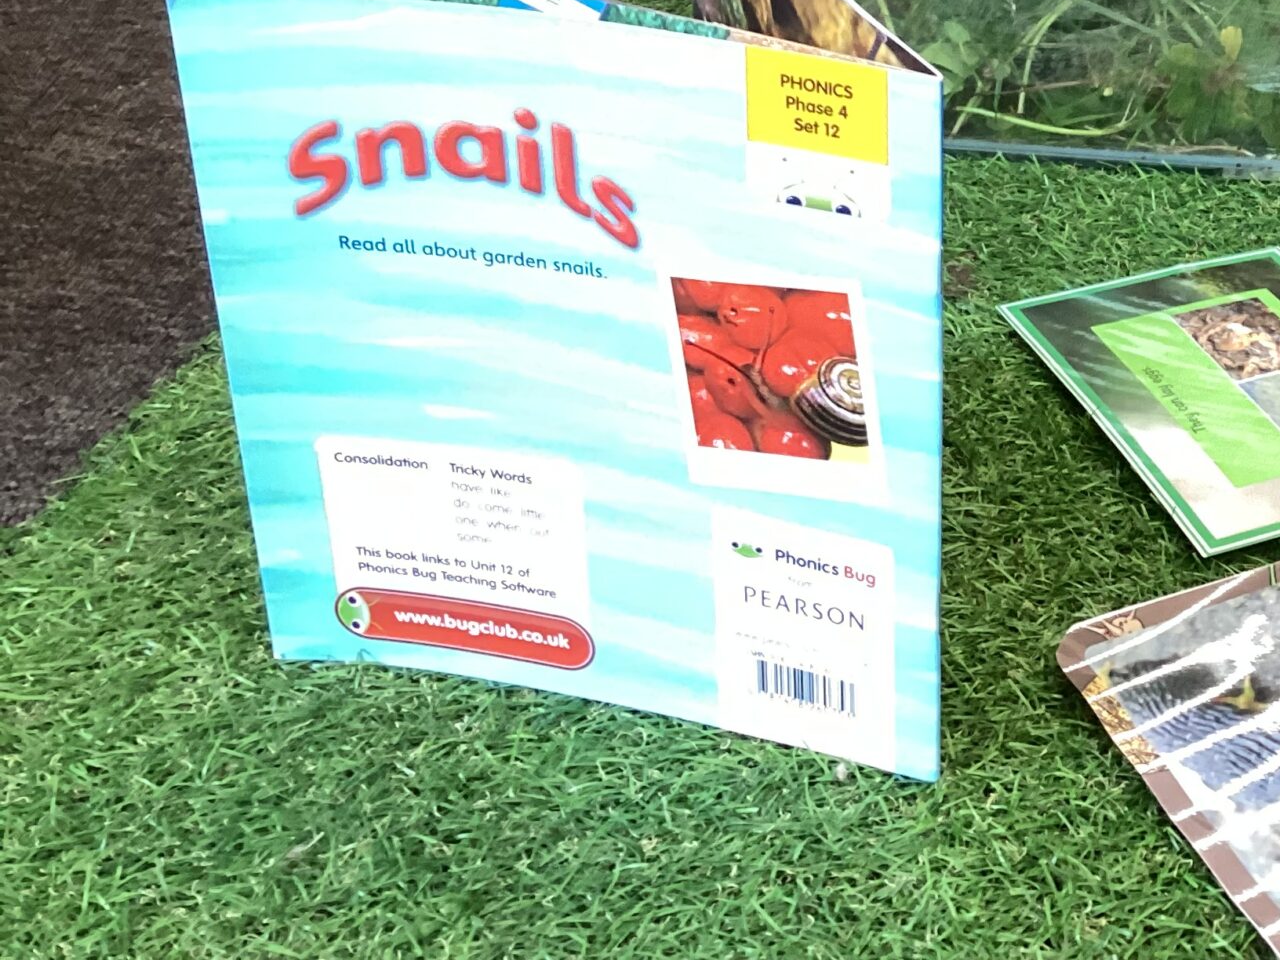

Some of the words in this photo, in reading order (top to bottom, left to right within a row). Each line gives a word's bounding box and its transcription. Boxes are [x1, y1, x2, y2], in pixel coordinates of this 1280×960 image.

[780, 73, 853, 99] PHONICS
[786, 95, 833, 116] Phase
[838, 105, 848, 119] 4
[794, 117, 819, 134] Set
[823, 122, 840, 139] 12
[338, 235, 387, 252] Read
[392, 238, 417, 254] all
[422, 242, 477, 260] about
[482, 250, 547, 269] garden
[553, 259, 608, 279] snails.
[1142, 365, 1164, 384] eggs
[1158, 383, 1176, 399] lay
[1170, 396, 1189, 413] can
[1184, 411, 1207, 435] They
[333, 452, 429, 470] Consolidation
[449, 462, 486, 479] Tricky
[490, 468, 533, 485] Words
[356, 546, 382, 559] This
[385, 548, 418, 563] book
[421, 553, 451, 567] links
[454, 557, 467, 569] to
[471, 560, 497, 574] Unit
[500, 564, 514, 577] 12
[518, 567, 531, 579] of
[775, 549, 839, 577] Phonics
[844, 565, 876, 588] Bug
[357, 561, 409, 578] Phonics
[412, 567, 438, 582] Bug
[441, 570, 498, 591] Teaching
[501, 580, 557, 599] Software
[744, 585, 865, 632] PEARSON
[394, 610, 571, 650] www.bugclub.co.uk
